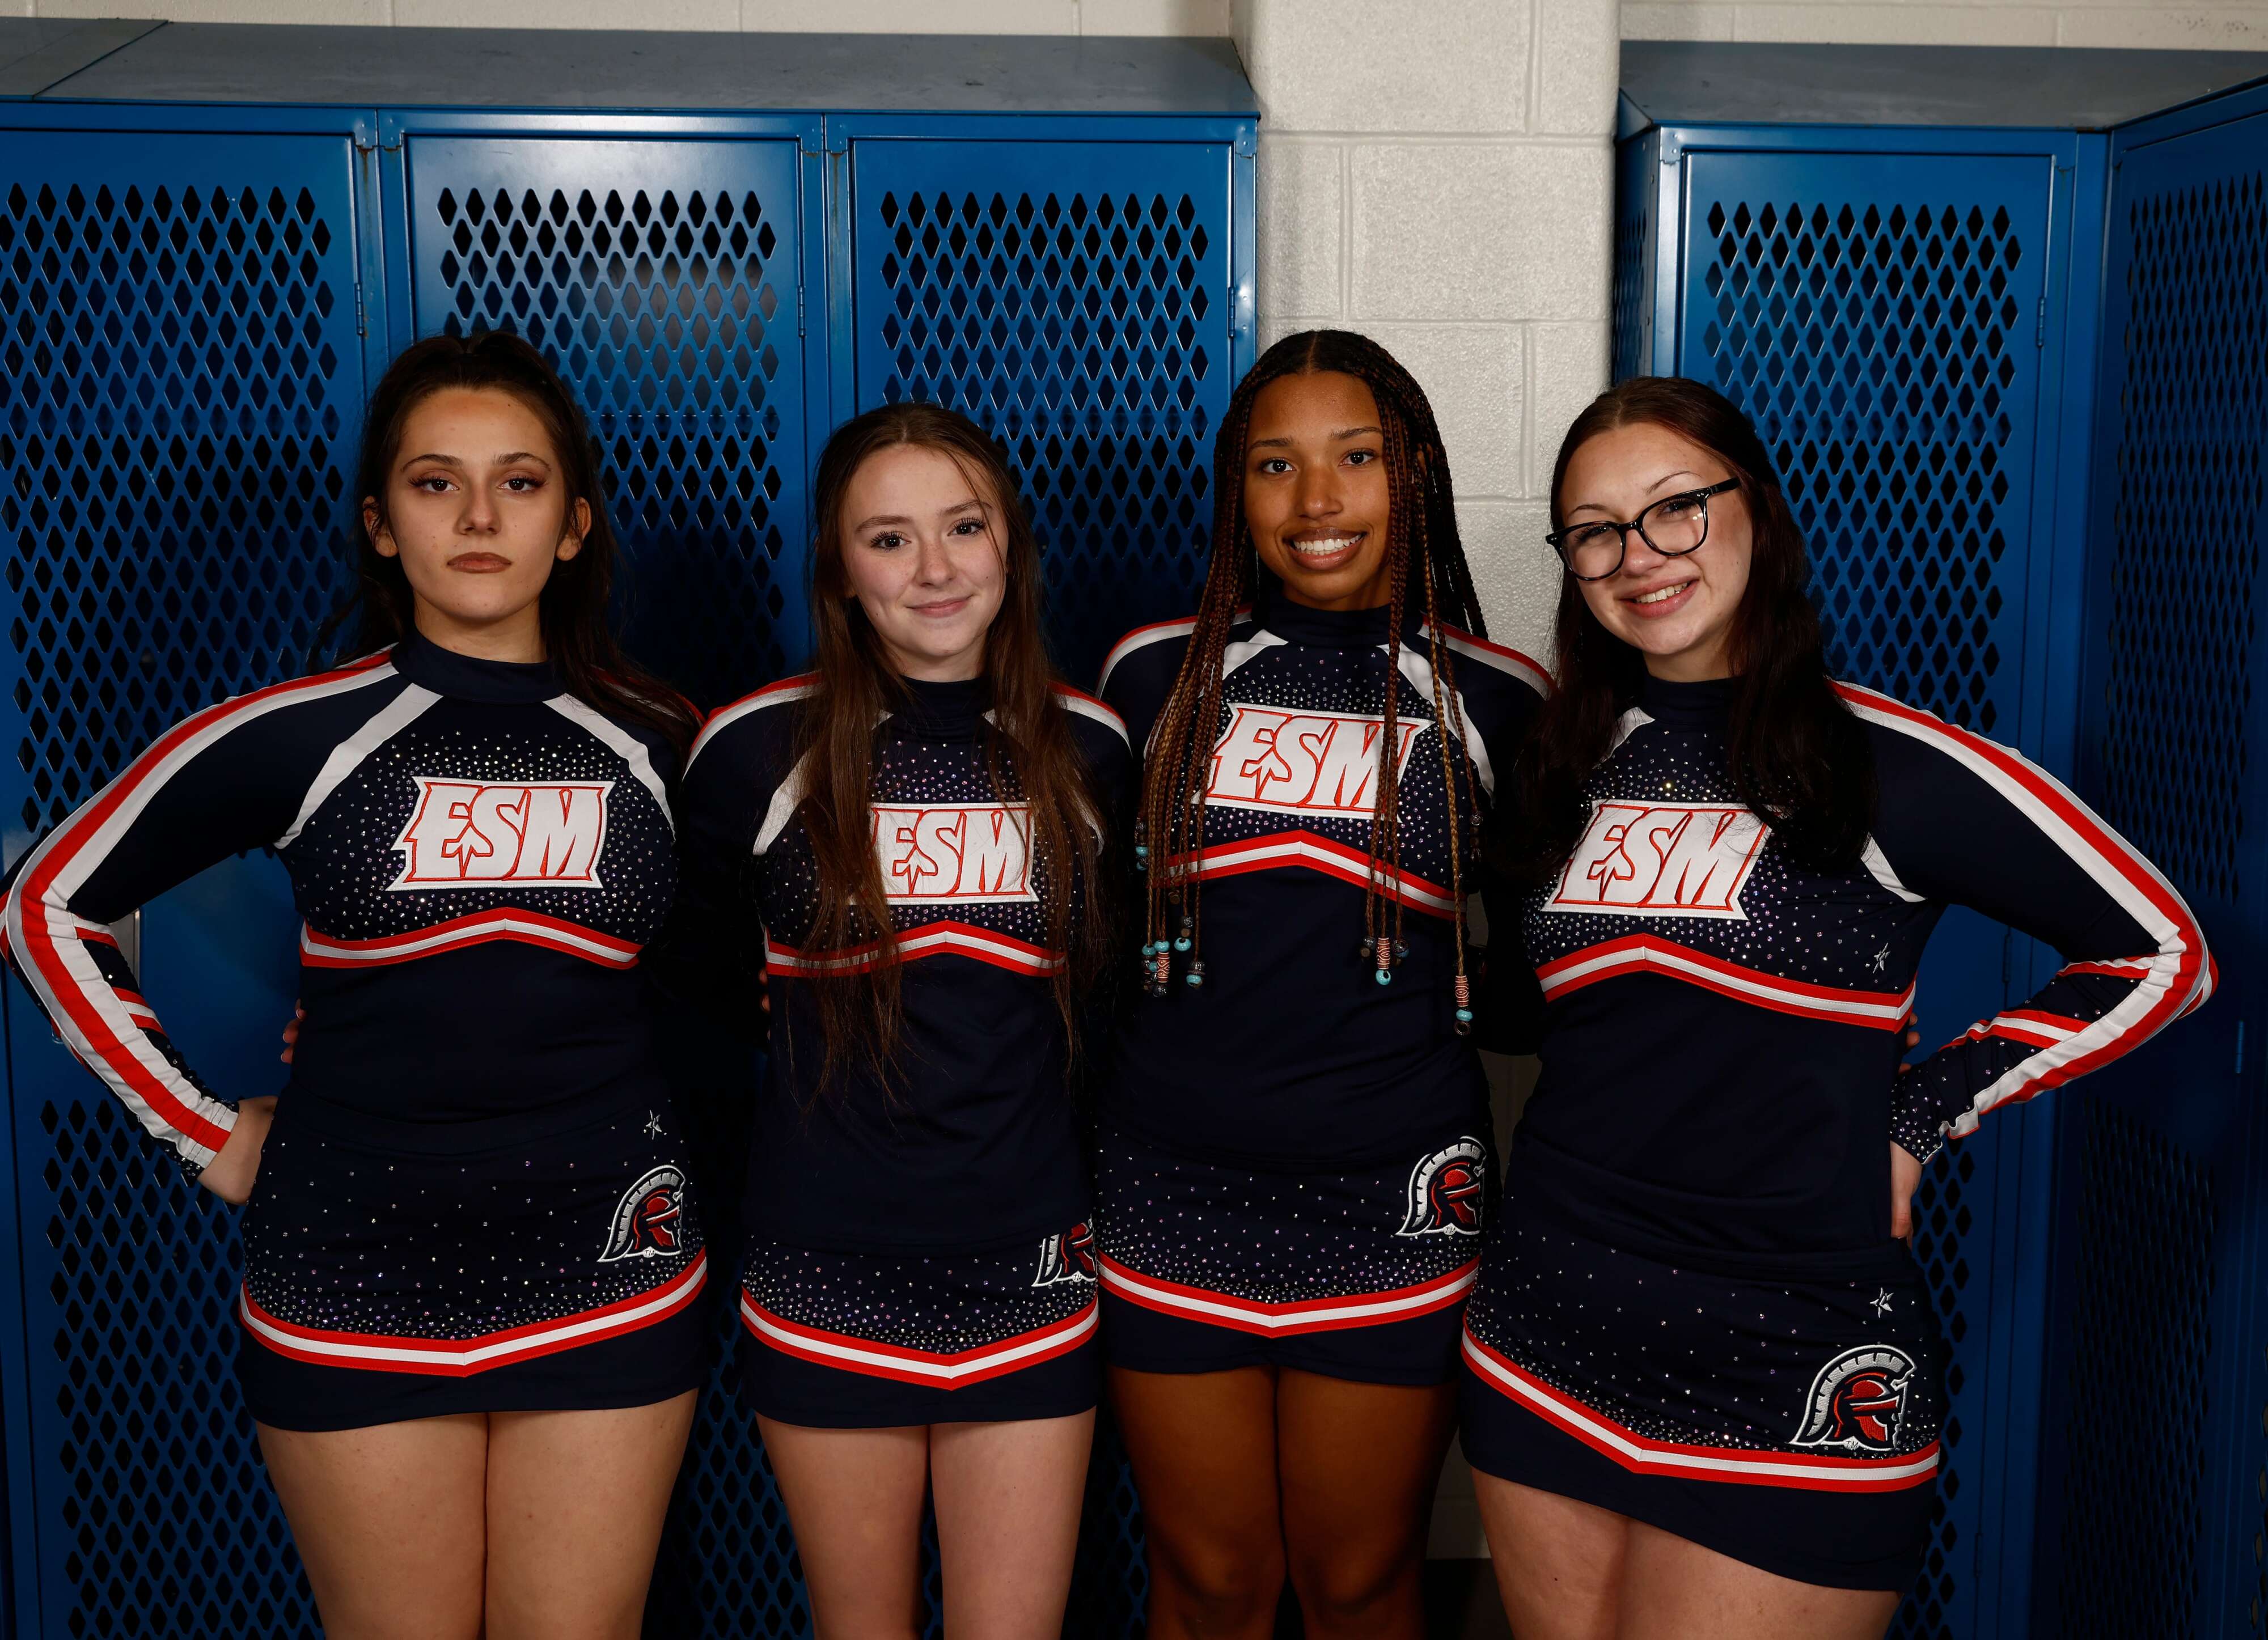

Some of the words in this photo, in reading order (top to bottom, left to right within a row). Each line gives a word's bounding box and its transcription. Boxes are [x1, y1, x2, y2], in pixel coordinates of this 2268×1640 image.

[1206, 707, 1420, 813] ESM
[403, 782, 606, 883] ESM
[871, 807, 1033, 898] ESM
[1552, 804, 1767, 912] ESM
[1846, 1440, 1859, 1448] TM
